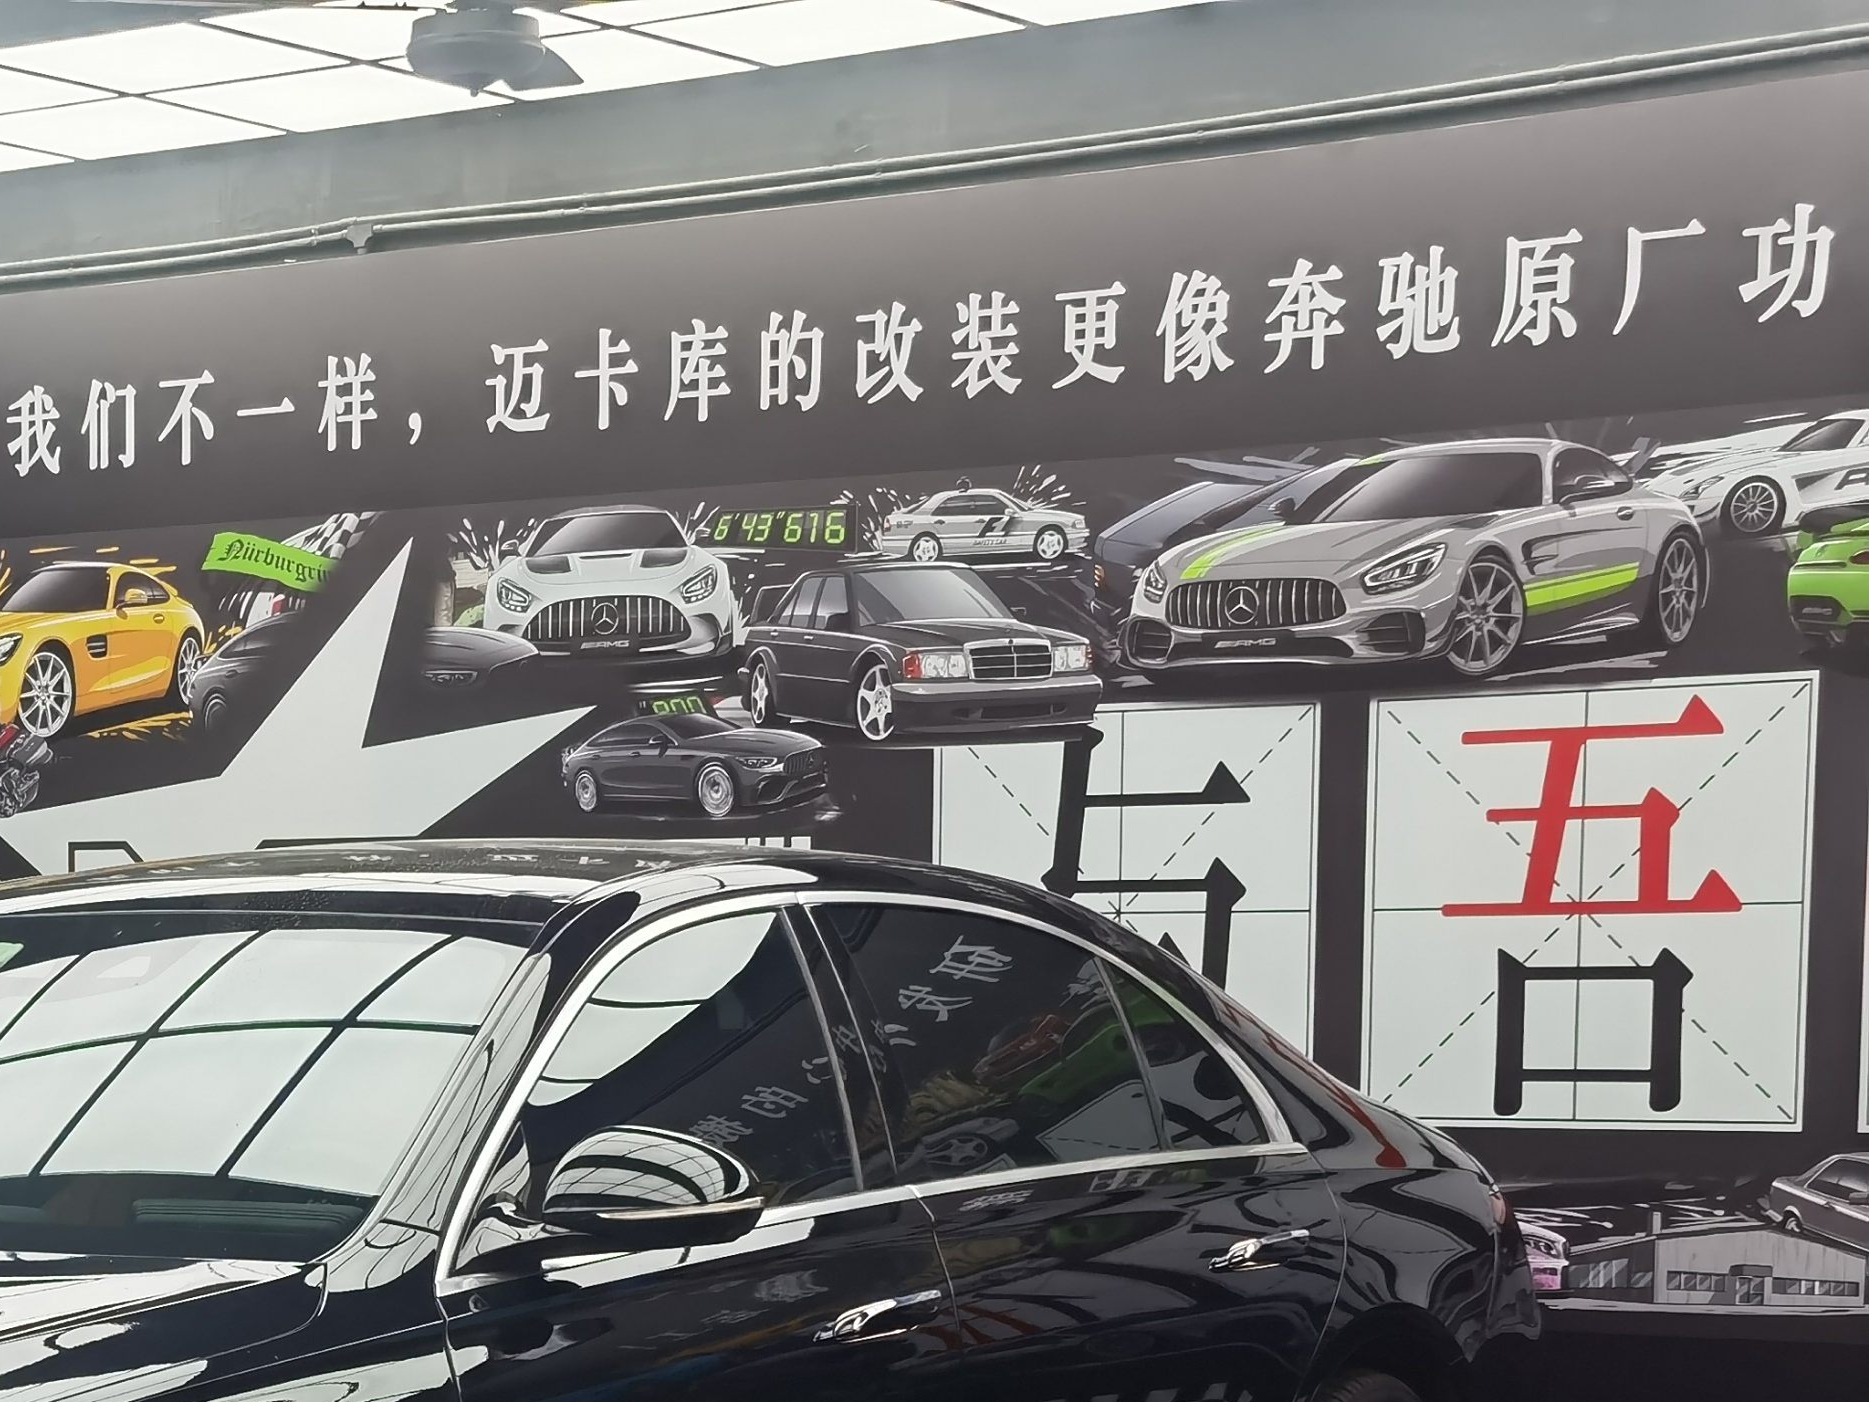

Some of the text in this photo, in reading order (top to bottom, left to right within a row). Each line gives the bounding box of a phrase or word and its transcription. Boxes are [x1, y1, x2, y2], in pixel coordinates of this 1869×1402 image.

[5, 202, 1836, 478] 我们不一样，迈卡库的改装更像奔驰原厂功
[1229, 638, 1277, 648] AMG
